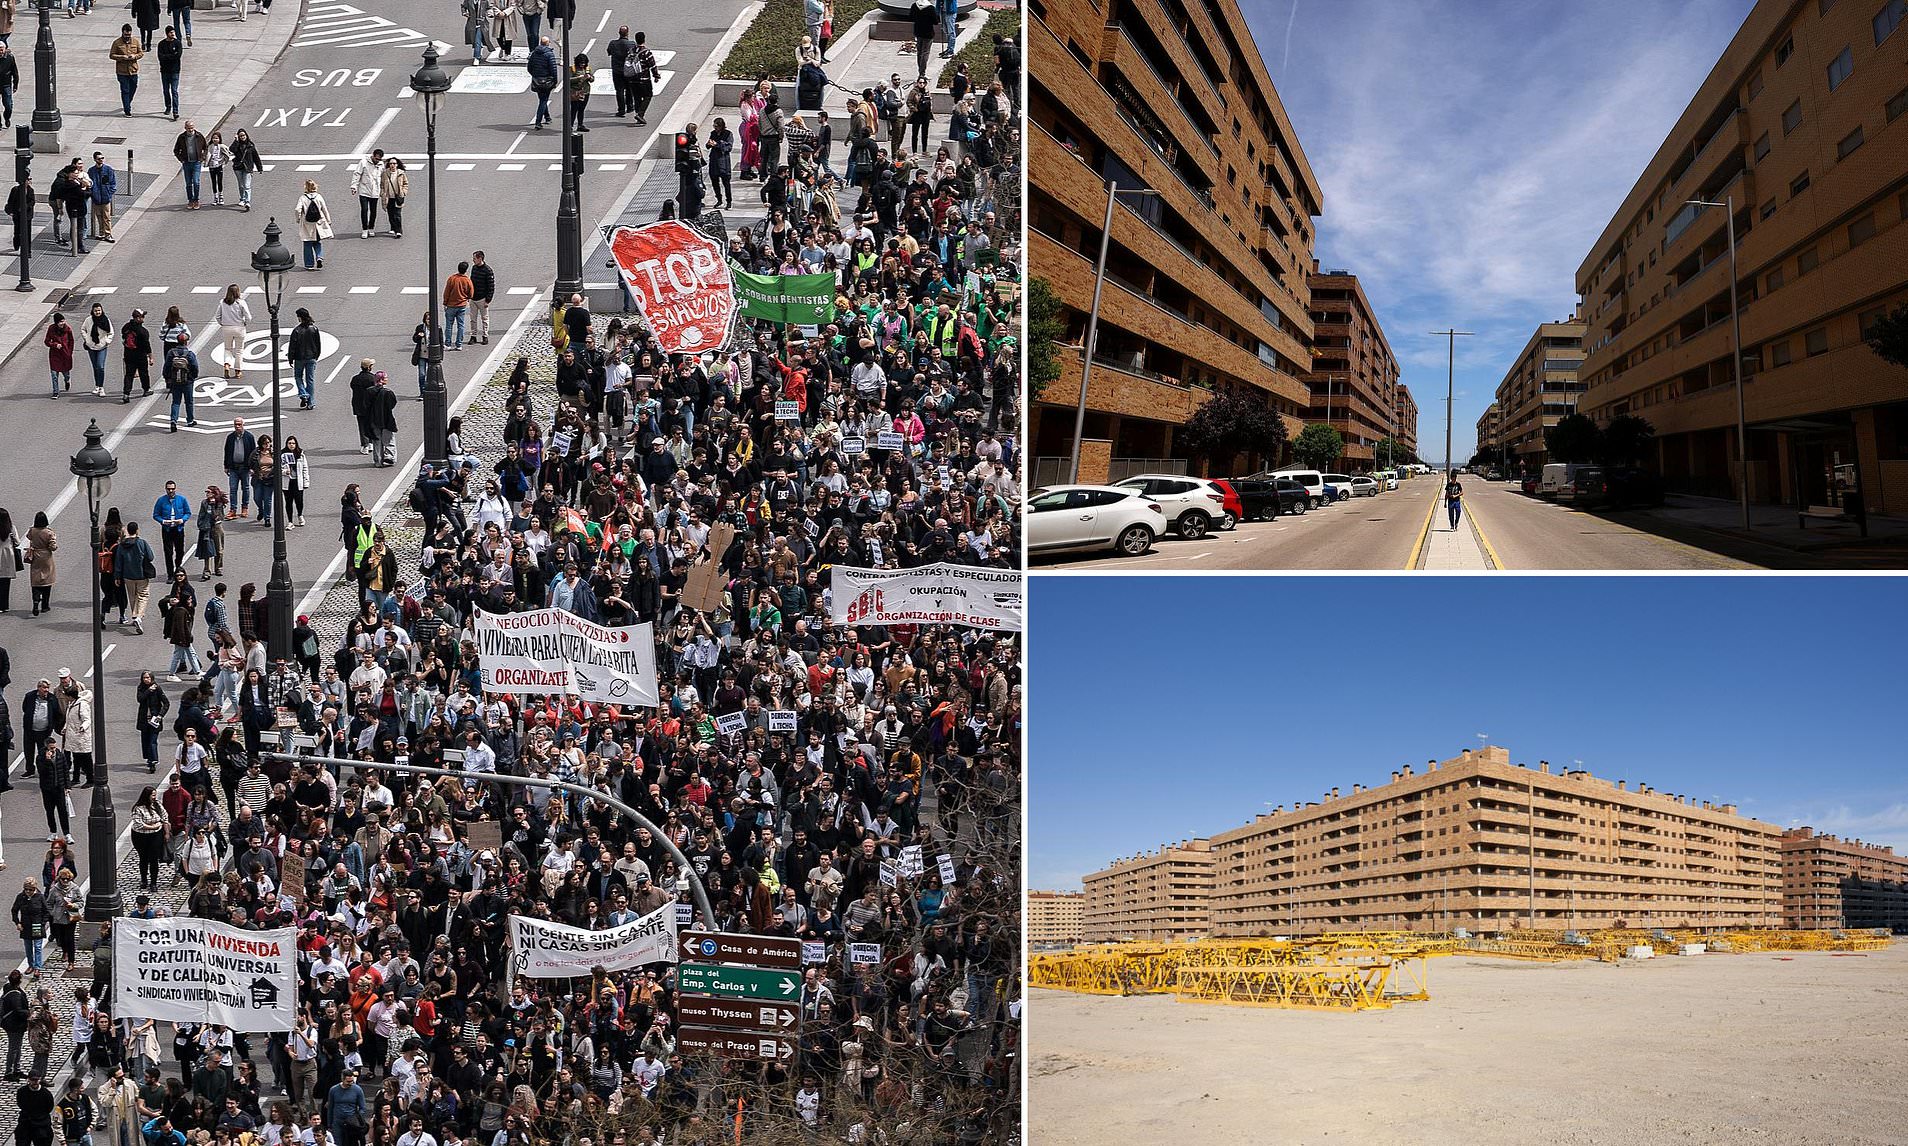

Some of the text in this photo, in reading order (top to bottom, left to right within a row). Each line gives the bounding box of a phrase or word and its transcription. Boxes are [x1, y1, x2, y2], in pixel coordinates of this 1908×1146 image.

[291, 68, 383, 87] BUS
[253, 107, 352, 127] TAXI
[745, 288, 779, 304] SOBRAN
[780, 294, 830, 305] RENTISTAS
[845, 570, 887, 579] CONTRA
[888, 568, 942, 578] RENTISTAS
[944, 568, 951, 576] Y
[909, 586, 967, 598] OKUPACIÓN
[934, 599, 942, 608] Y
[876, 610, 1001, 627] ORGANIZACIÓN DE CLASE
[496, 612, 550, 629] NEGOCIO
[565, 615, 618, 643] RENTISTAS
[484, 629, 531, 659] VIVIENDA
[531, 633, 560, 661] PARA
[560, 633, 587, 664] QUIEN
[599, 648, 640, 675] HABITA
[719, 713, 741, 725] DERECHO
[771, 712, 794, 720] DERECHO
[519, 922, 535, 936] NI
[538, 928, 586, 942] GENTE
[589, 933, 614, 942] SIN
[617, 911, 663, 939] CASAS
[139, 929, 281, 957] POR UNA VIVIENDA
[520, 921, 666, 952] NI CASAS SIN GENTE
[721, 944, 742, 953] Casa
[747, 946, 758, 955] de
[762, 947, 797, 958] América
[853, 944, 878, 953] DERECHO
[207, 953, 282, 975] UNIVERSAL
[138, 968, 226, 985] Y DE CALIDAD
[683, 969, 703, 977] plaza
[682, 978, 758, 992] Emp. Carlos V
[137, 986, 182, 1000] SINDICATO
[183, 988, 218, 1002] VIVIENDA
[219, 991, 246, 1009] TETUÁN
[681, 1007, 752, 1019] museo Thyssen
[711, 1041, 723, 1049] del
[727, 1041, 756, 1051] Prado
